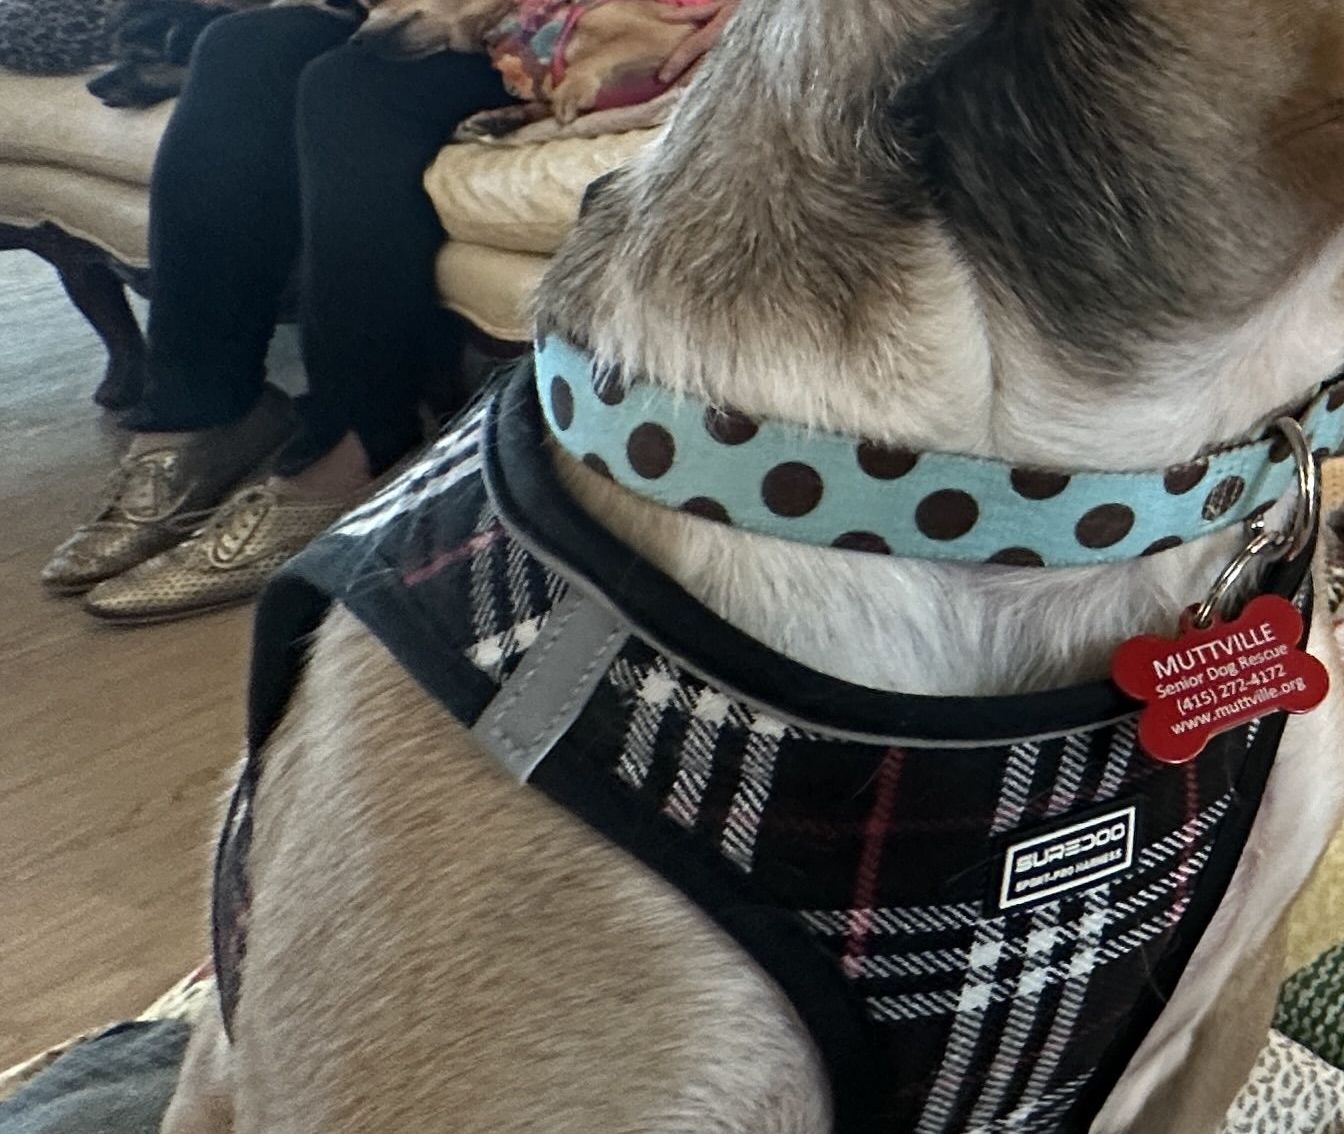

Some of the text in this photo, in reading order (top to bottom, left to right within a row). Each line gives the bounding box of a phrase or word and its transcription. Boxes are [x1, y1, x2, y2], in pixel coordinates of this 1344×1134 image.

[1152, 623, 1276, 680] MUTTVILLE
[1155, 642, 1289, 700] Senior Dog Rescue
[1170, 677, 1307, 736] www.muttville.org
[1176, 663, 1287, 716] (415) 272-4172
